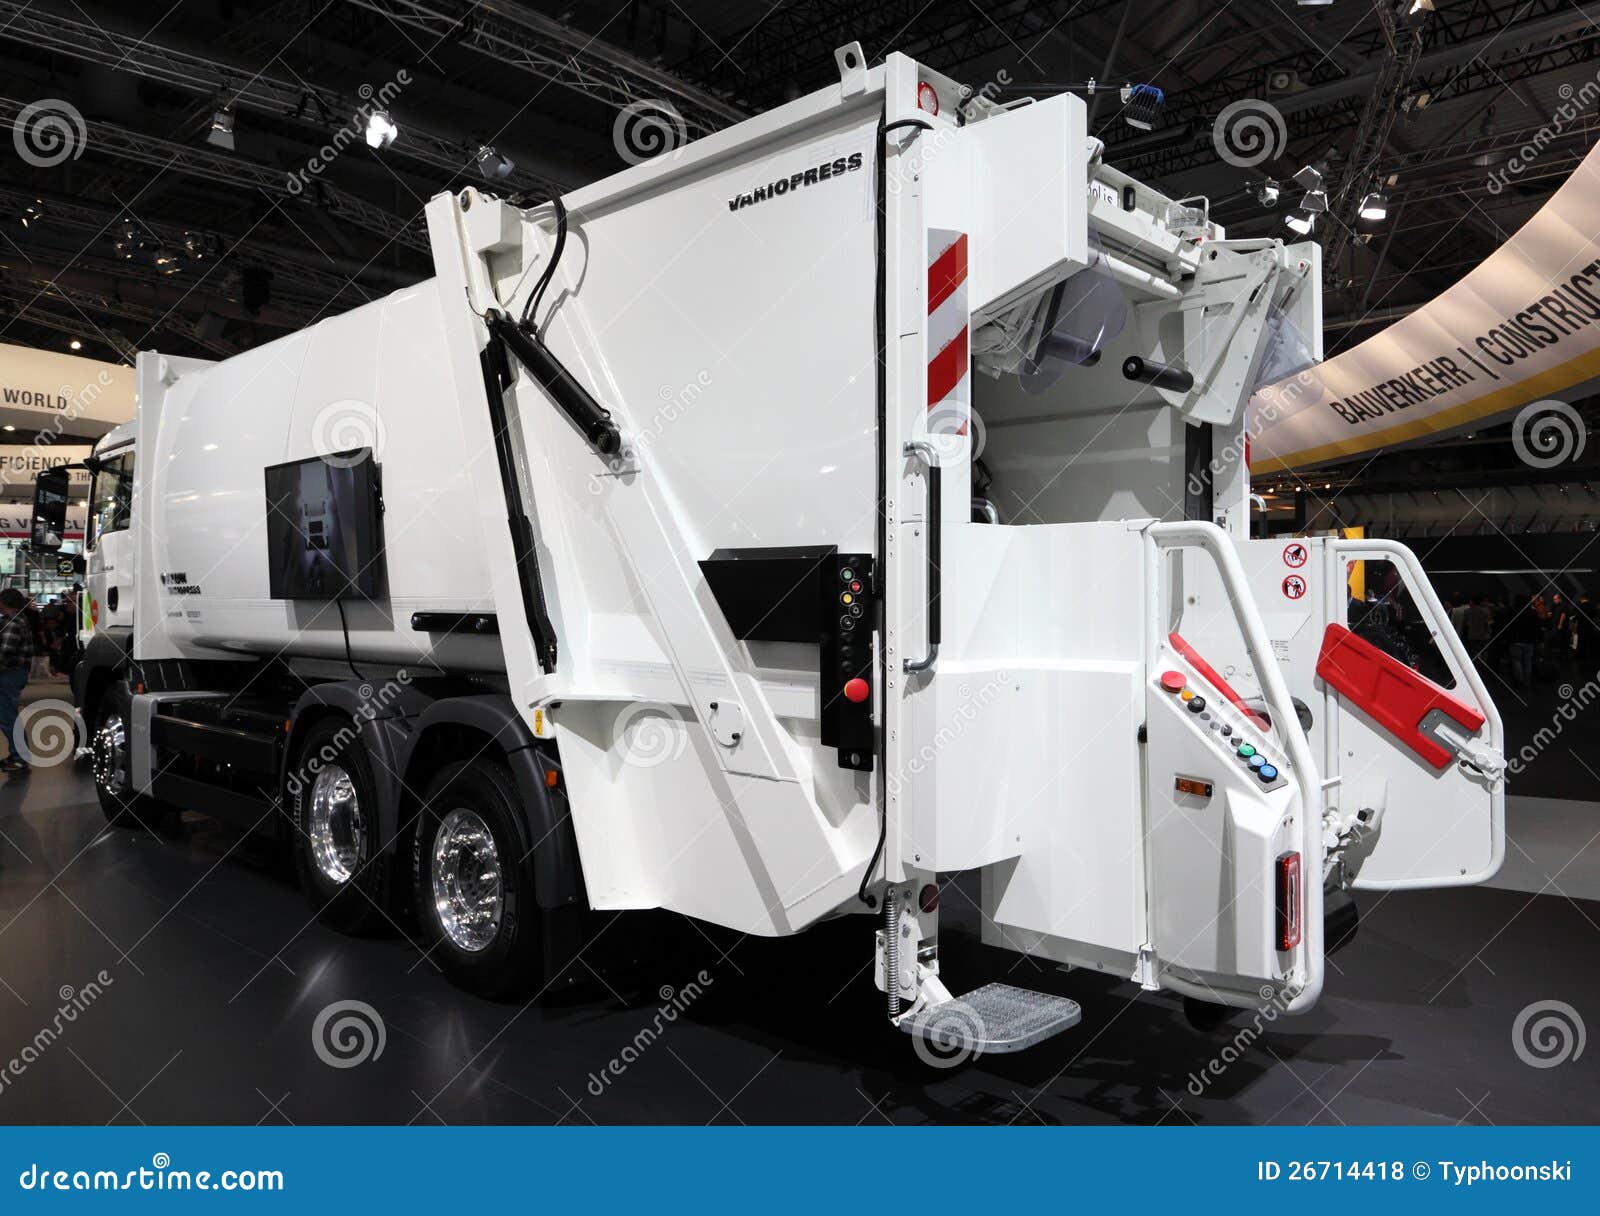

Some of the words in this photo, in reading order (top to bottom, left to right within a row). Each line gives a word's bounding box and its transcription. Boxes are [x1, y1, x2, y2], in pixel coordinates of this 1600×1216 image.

[728, 152, 864, 212] VARIOPRESS
[1089, 185, 1113, 205] olis
[1329, 356, 1475, 425] BAUVERKEHR
[1475, 259, 1600, 366] CONSTRUCT
[3, 387, 68, 411] WORLD
